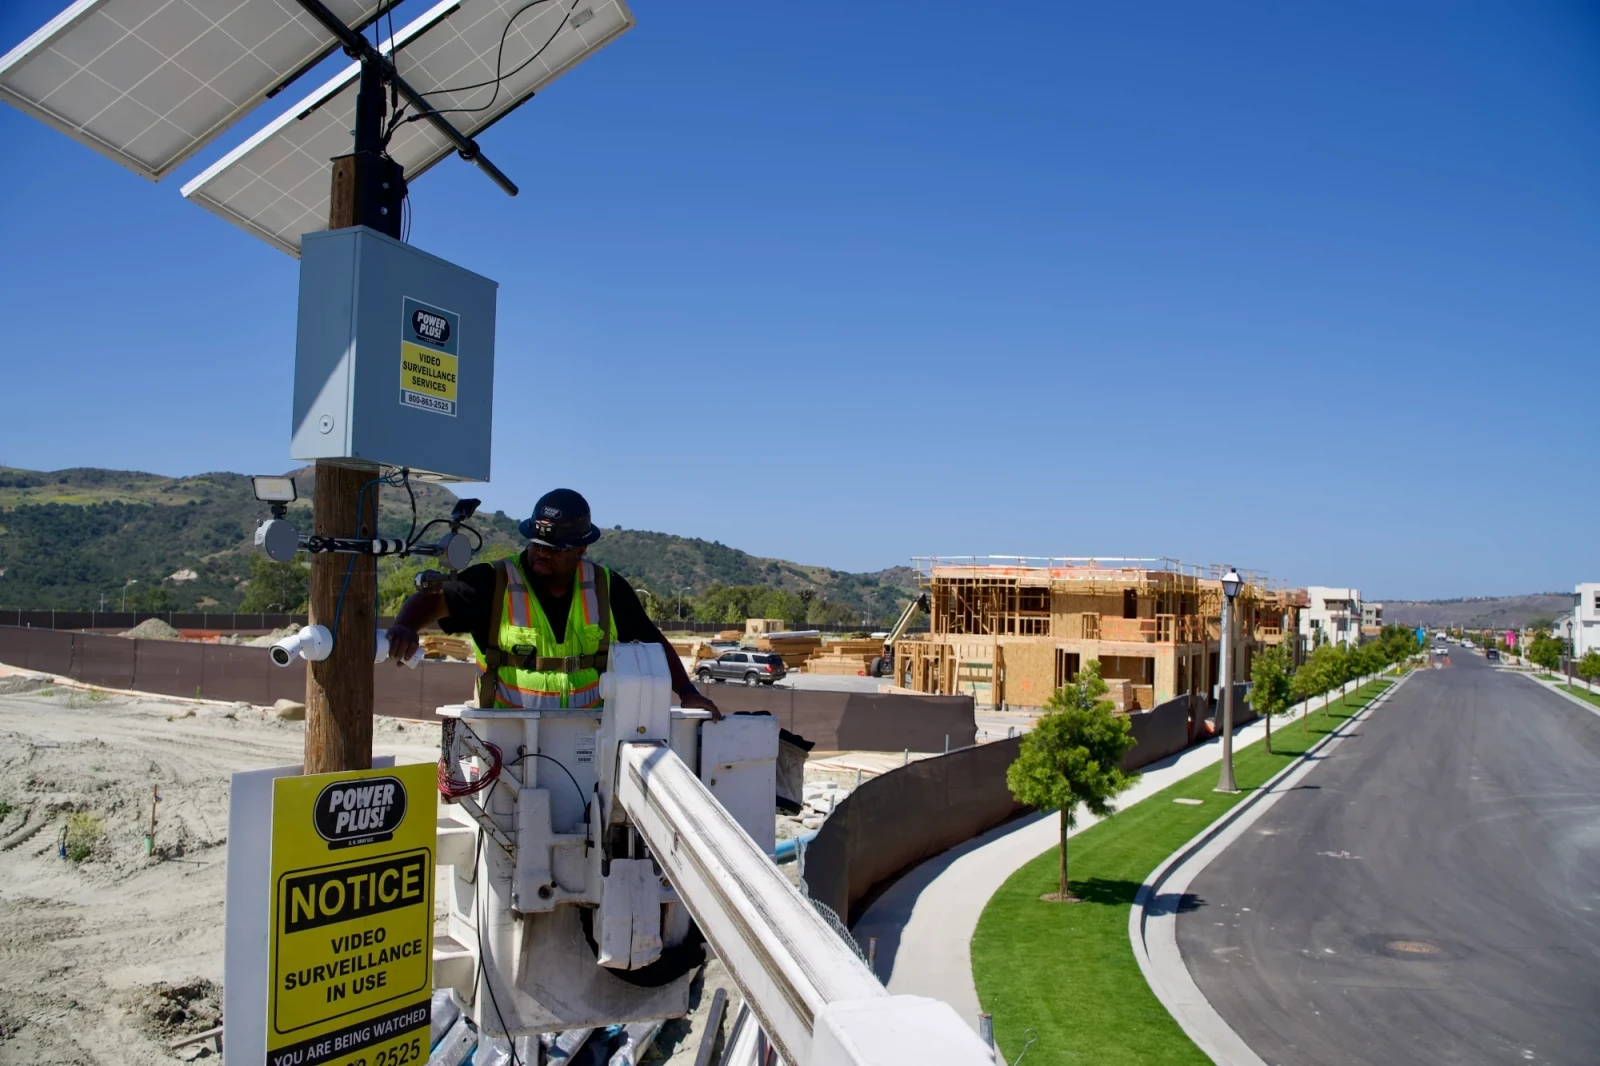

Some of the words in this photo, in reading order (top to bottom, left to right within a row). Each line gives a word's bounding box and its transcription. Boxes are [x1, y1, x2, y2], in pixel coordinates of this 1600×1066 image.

[417, 312, 446, 330] POWER
[420, 323, 442, 339] PLUS!
[403, 360, 456, 383] SURVEILLANCE
[419, 353, 441, 367] VIDEO
[412, 375, 447, 393] SERVICES
[408, 394, 449, 411] 800-863-2525
[329, 784, 396, 813] POWER
[335, 806, 386, 834] PLUS!
[291, 863, 420, 924] NOTICE
[331, 927, 386, 954] VIDEO
[284, 939, 423, 990] SURVEILLANCE
[326, 982, 346, 1003] IN
[352, 971, 387, 994] USE
[274, 1049, 303, 1066] YOU
[306, 1039, 332, 1061] ARE
[334, 1028, 371, 1051] BEING
[373, 1008, 427, 1037] WATCHED
